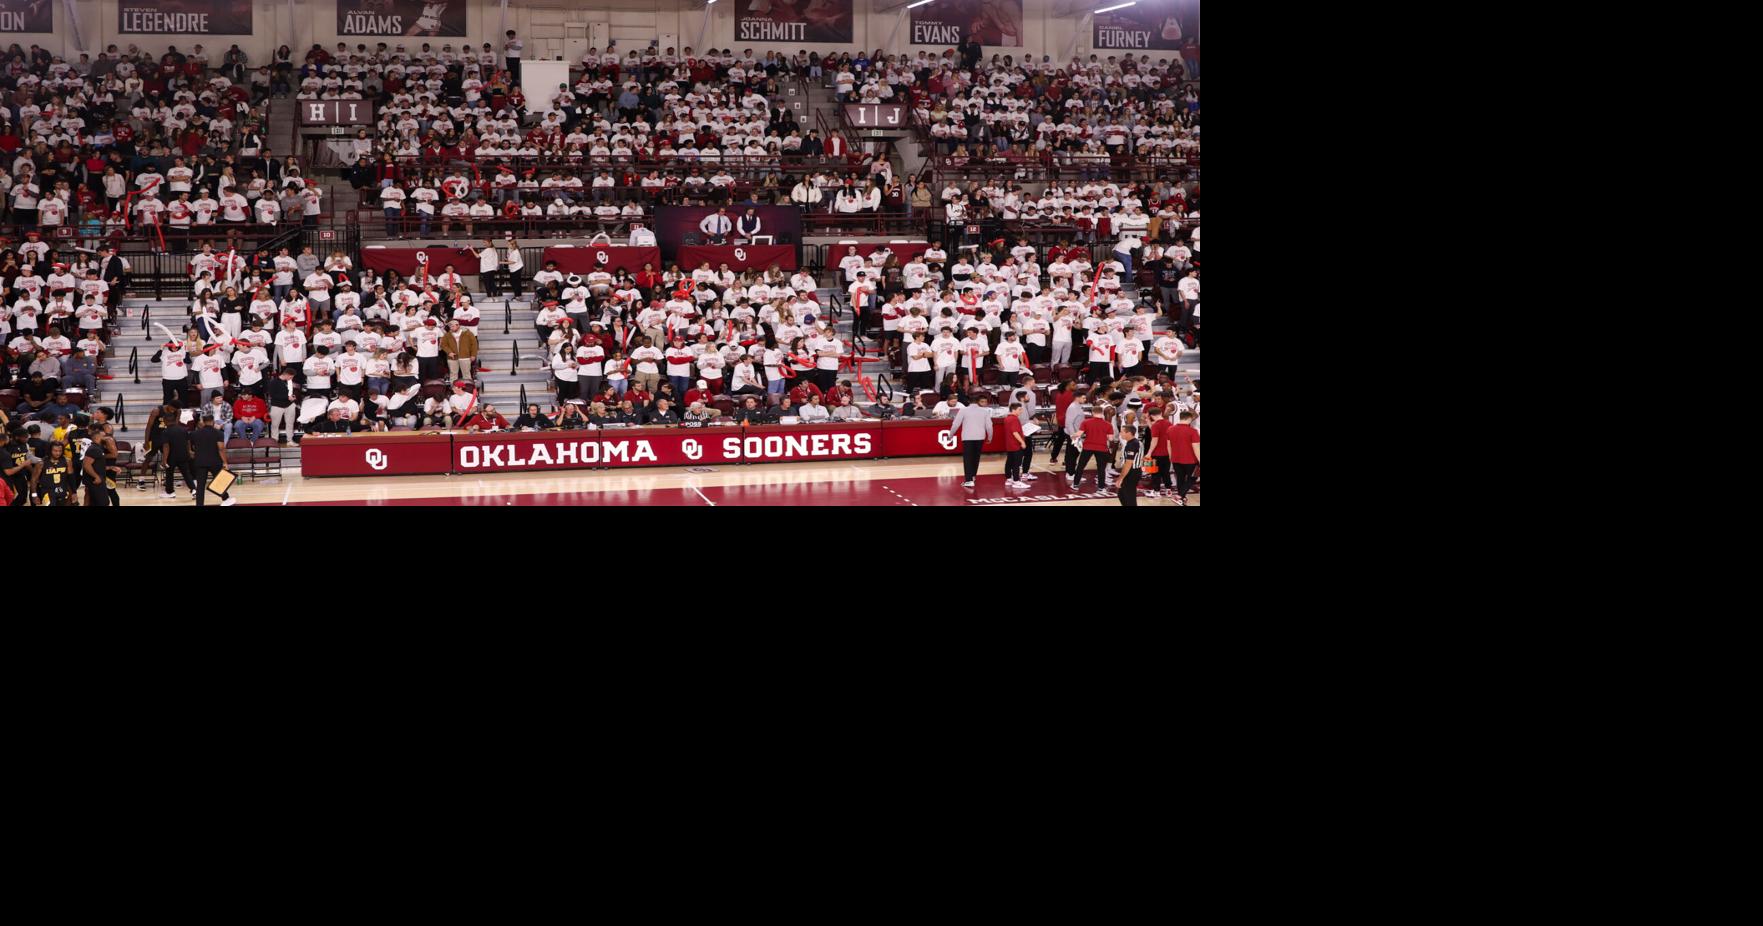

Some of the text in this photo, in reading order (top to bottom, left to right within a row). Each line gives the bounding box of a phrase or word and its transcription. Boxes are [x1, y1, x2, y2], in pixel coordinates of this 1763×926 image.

[123, 12, 209, 32] LEGENDRE
[343, 14, 402, 34] ADAMS
[740, 21, 807, 40] SCHMITT
[914, 25, 960, 43] EVANS
[1098, 29, 1151, 48] FURNEY
[309, 103, 358, 121] H I
[858, 107, 901, 124] I J
[596, 250, 609, 265] OU
[734, 247, 747, 262] OU
[937, 429, 958, 450] OU
[365, 448, 388, 470] OU
[460, 432, 873, 468] OKLAHOMA OU SOONERS
